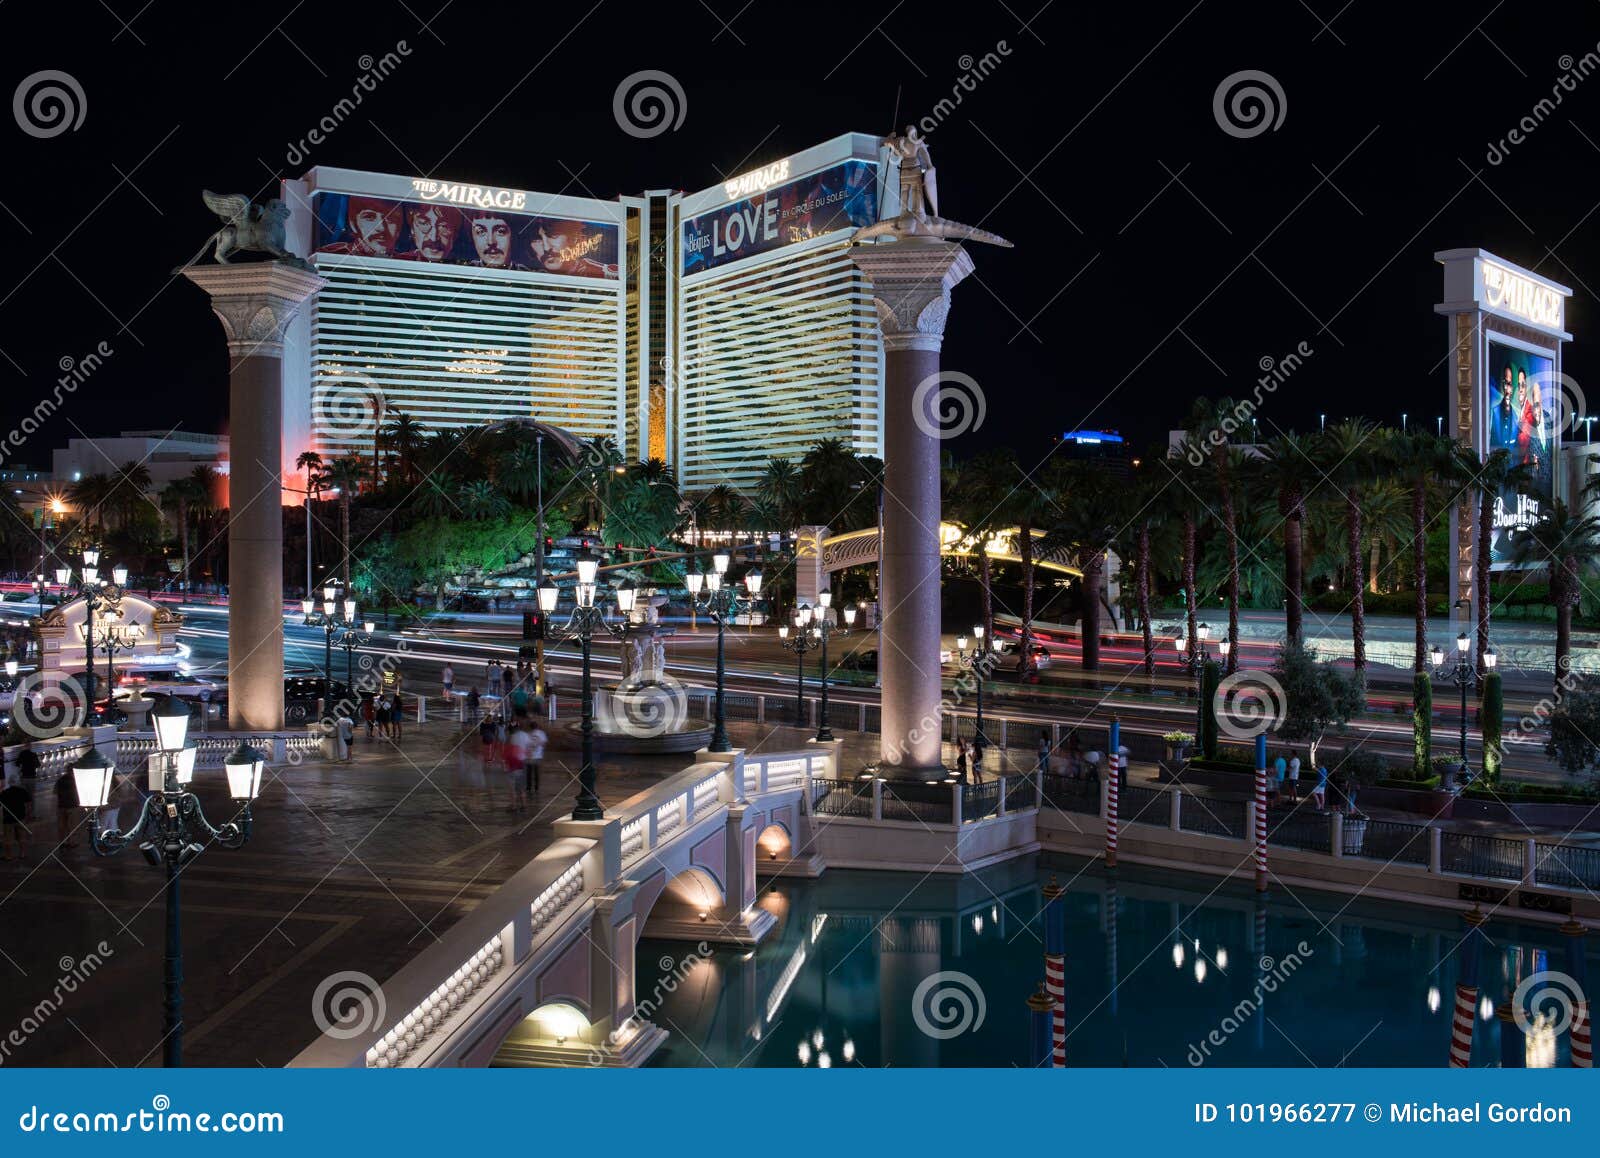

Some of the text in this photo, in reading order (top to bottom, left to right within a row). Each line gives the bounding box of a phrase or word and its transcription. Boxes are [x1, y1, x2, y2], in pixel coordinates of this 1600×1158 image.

[412, 180, 526, 209] THE MIRAGE
[729, 160, 789, 199] MIRAGE
[815, 197, 826, 208] DU
[826, 190, 849, 204] SOLEIL
[713, 199, 779, 257] LOVE
[1487, 271, 1561, 328] MIRAGE
[79, 624, 145, 641] VENTIN
